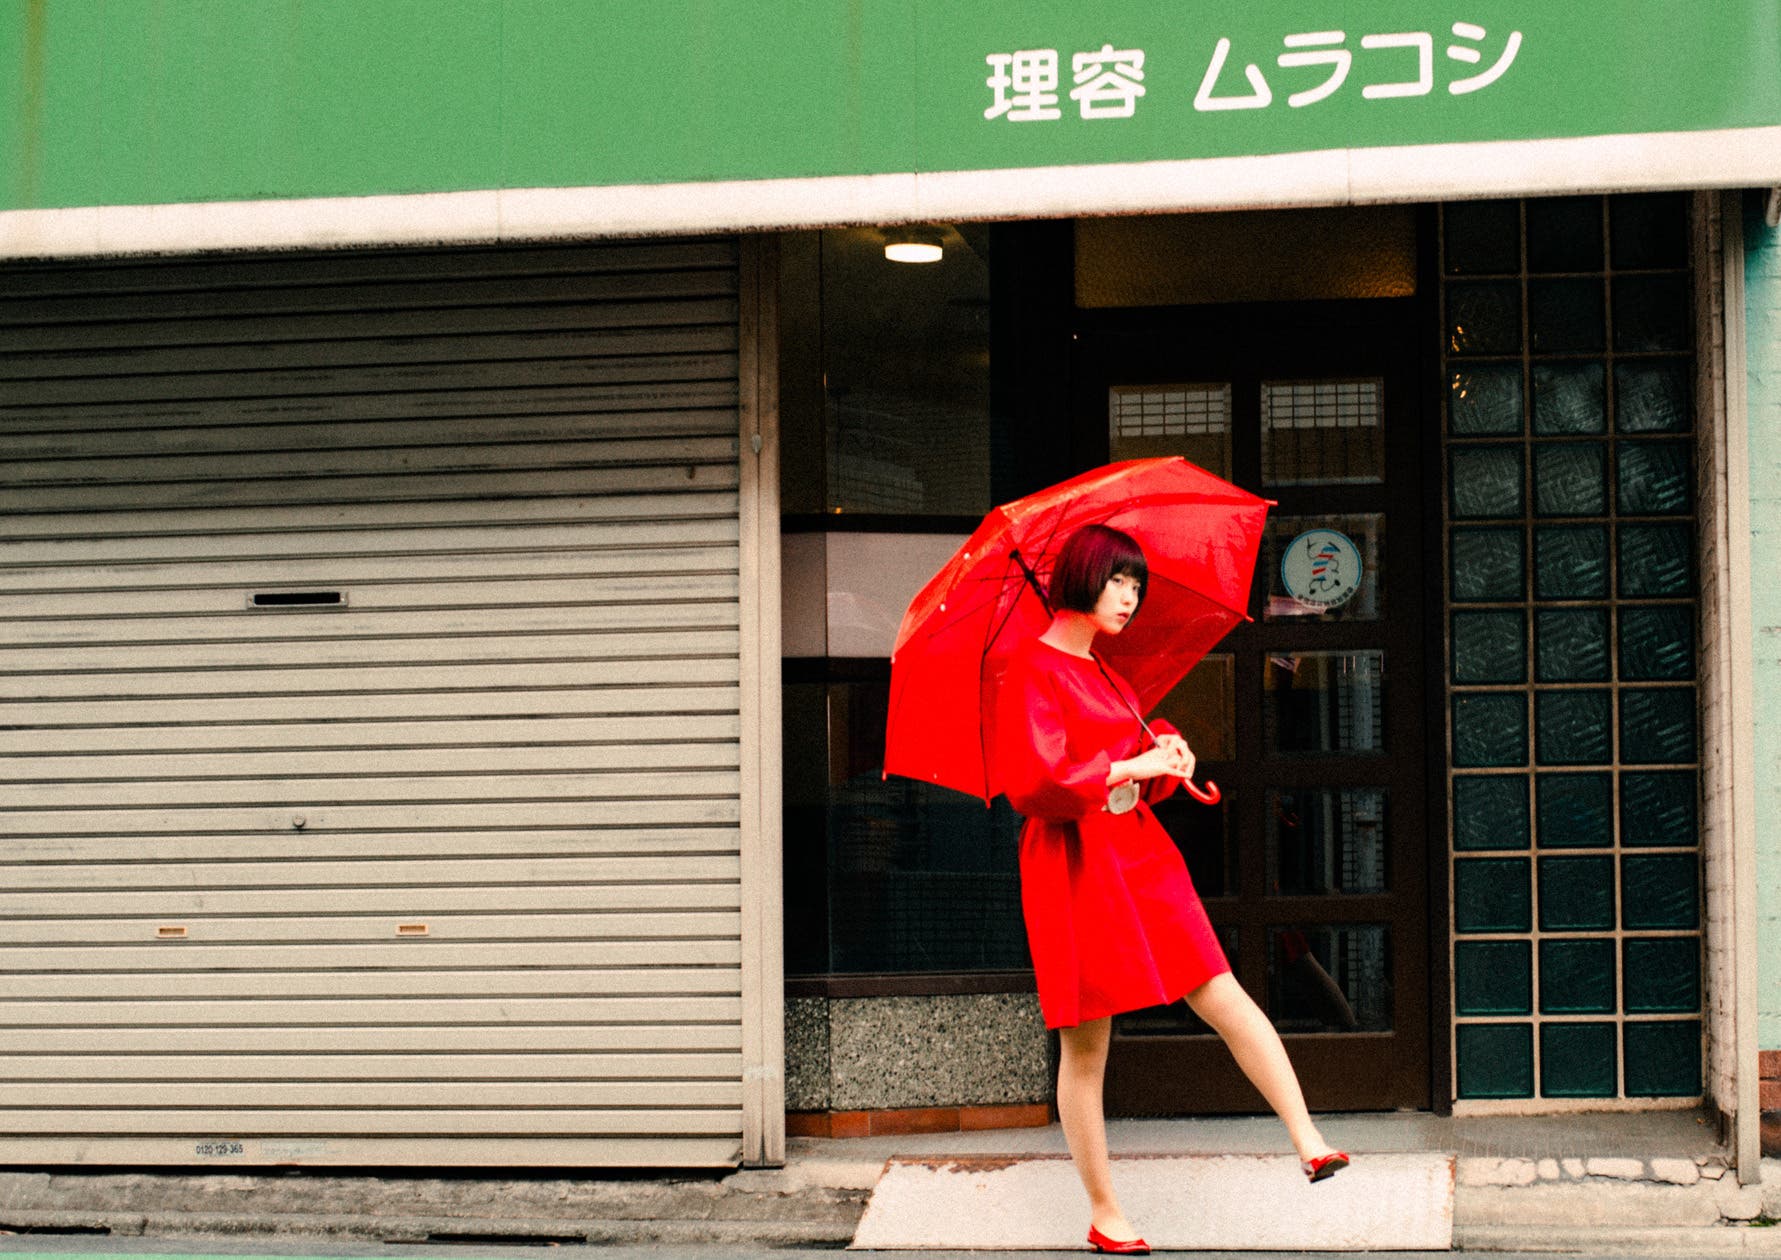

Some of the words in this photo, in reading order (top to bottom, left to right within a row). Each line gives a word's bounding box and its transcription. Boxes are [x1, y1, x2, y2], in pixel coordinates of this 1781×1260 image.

[983, 44, 1146, 122] 理容
[1193, 22, 1523, 111] ムラコシ
